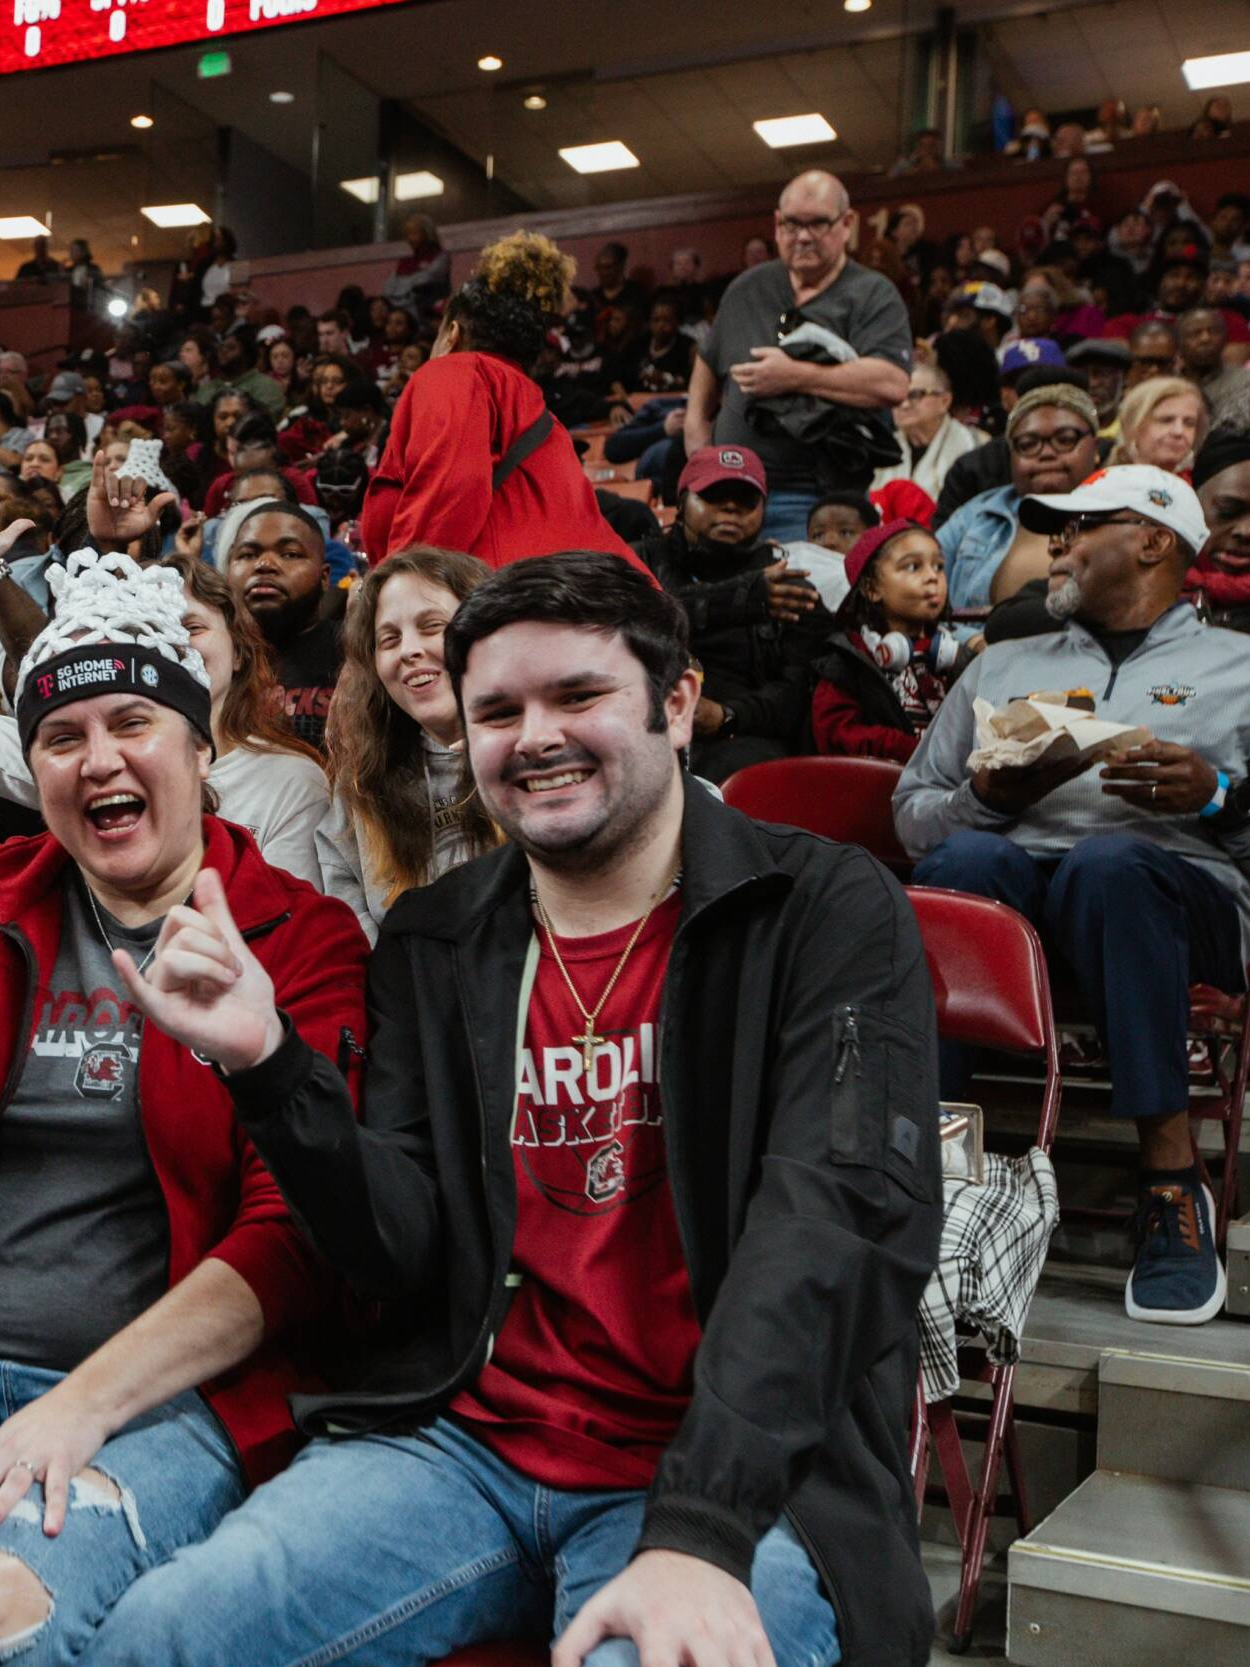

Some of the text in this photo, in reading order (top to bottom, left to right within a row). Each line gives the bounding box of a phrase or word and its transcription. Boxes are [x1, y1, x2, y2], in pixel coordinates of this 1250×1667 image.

[56, 659, 113, 679] 5G HOME
[58, 669, 117, 692] INTERNET
